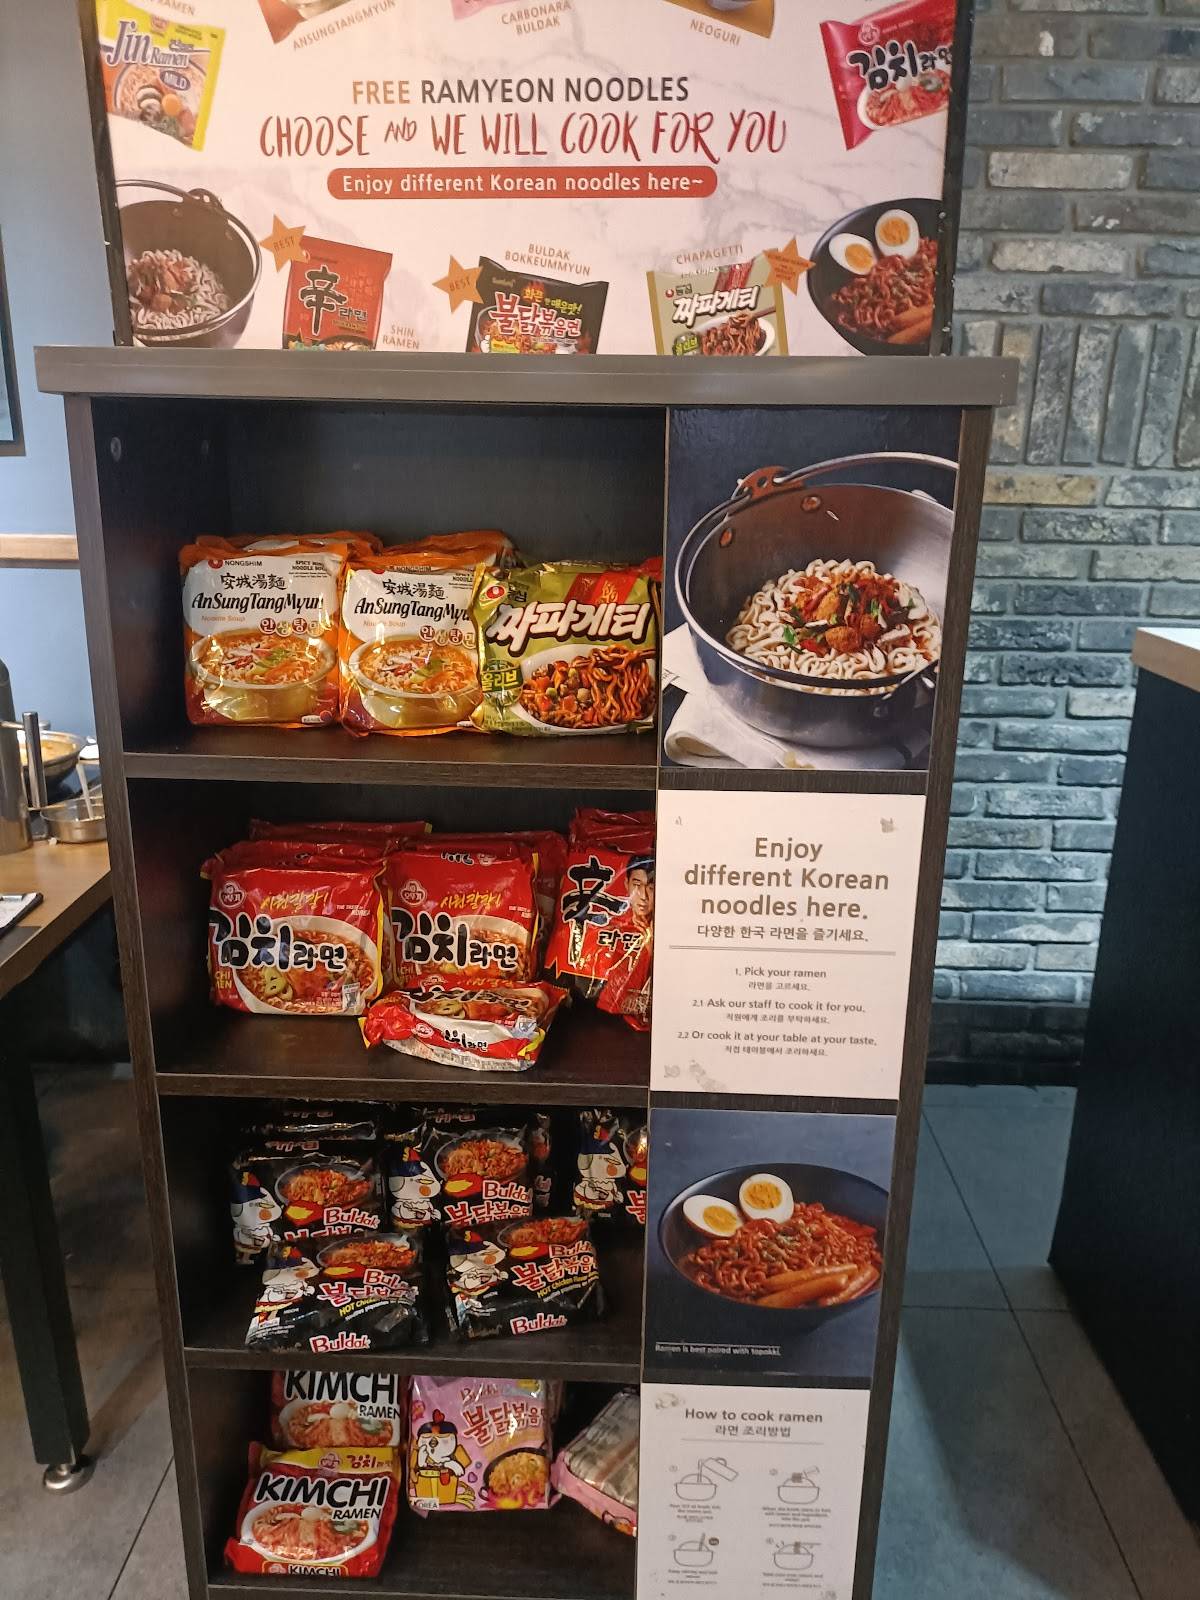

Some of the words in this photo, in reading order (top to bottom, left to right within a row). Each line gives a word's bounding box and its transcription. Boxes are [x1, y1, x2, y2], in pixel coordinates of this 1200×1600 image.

[501, 0, 572, 26] CARBONARA
[292, 0, 396, 51] ANSUNGTANGMYUN
[515, 16, 561, 36] BULDAK
[690, 19, 742, 47] NEOGURI
[107, 20, 151, 65] Jin
[150, 47, 188, 66] Ramen
[163, 72, 187, 88] MILD
[352, 80, 411, 105] FREE
[421, 77, 553, 104] RAMYEON
[565, 76, 689, 102] NOODLES
[260, 115, 370, 158] CHOOSE
[384, 117, 417, 143] AND
[430, 113, 467, 155] WE
[481, 112, 547, 155] WILL
[561, 110, 641, 162] COOK
[651, 110, 720, 164] FOR
[727, 109, 787, 153] YOU
[343, 175, 393, 194] Enjoy
[401, 174, 483, 192] different
[490, 174, 556, 191] Korean
[565, 173, 640, 191] noodles
[647, 172, 703, 190] here~
[273, 236, 295, 251] BEST
[529, 243, 570, 261] BULDAK
[504, 251, 591, 277] BOKKEUMMYUN
[676, 245, 743, 265] CHAPAGETTI
[450, 276, 471, 292] BEST
[299, 264, 348, 336] 辛
[672, 284, 761, 328] 짜파게티
[338, 307, 367, 321] 라면
[488, 291, 582, 337] 불닭볶음면
[391, 324, 414, 337] SHIN
[382, 335, 420, 350] RAMEN
[220, 572, 287, 590] 安城湯麵
[382, 579, 446, 600] 安城湯麵
[191, 592, 324, 615] AnSungTangMyun
[354, 597, 471, 625] AnSungTangMyu
[485, 599, 650, 658] 짜파게티
[482, 672, 519, 692] 올리브
[755, 837, 823, 862] Enjoy
[684, 864, 792, 887] different
[801, 868, 889, 890] Korean
[701, 895, 797, 917] noodles
[807, 896, 868, 920] here.
[208, 907, 347, 972] 김치라면
[391, 906, 518, 971] 김치라면
[697, 925, 736, 939] 다양한
[740, 926, 765, 940] 한국
[770, 927, 807, 941] 라면을
[814, 928, 869, 942] 즐기세요.
[744, 967, 765, 977] Pick
[767, 969, 792, 980] your
[794, 970, 827, 978] ramen
[748, 981, 772, 990] 라면을
[707, 999, 726, 1008] Ask
[728, 1001, 746, 1009] our
[749, 1000, 772, 1009] staff
[775, 1001, 786, 1010] to
[788, 1001, 813, 1011] cook
[816, 1002, 823, 1011] it
[826, 1002, 841, 1012] for
[844, 1004, 866, 1014] you.
[691, 1031, 704, 1040] Or
[707, 1031, 731, 1040] cook
[734, 1031, 741, 1041] it
[743, 1032, 754, 1041] at
[756, 1033, 780, 1044] your
[782, 1033, 808, 1043] table
[810, 1035, 821, 1044] at
[823, 1036, 847, 1046] your
[483, 1180, 533, 1203] Bulda
[323, 1207, 381, 1229] Buldak
[511, 1255, 594, 1291] 불닭볶음
[339, 1303, 356, 1316] HOT
[510, 1313, 568, 1335] Buldak
[309, 1331, 372, 1353] Buldak
[285, 1370, 400, 1405] KIMCHI
[359, 1404, 400, 1419] RAMEN
[685, 1408, 717, 1420] How
[722, 1409, 736, 1421] to
[740, 1410, 775, 1422] cook
[778, 1413, 823, 1423] ramen
[715, 1425, 739, 1436] 라면
[742, 1426, 791, 1437] 조리방법
[254, 1473, 390, 1509] KIMCHI
[332, 1508, 381, 1521] RAMEN
[288, 1565, 340, 1577] KIMCHI
